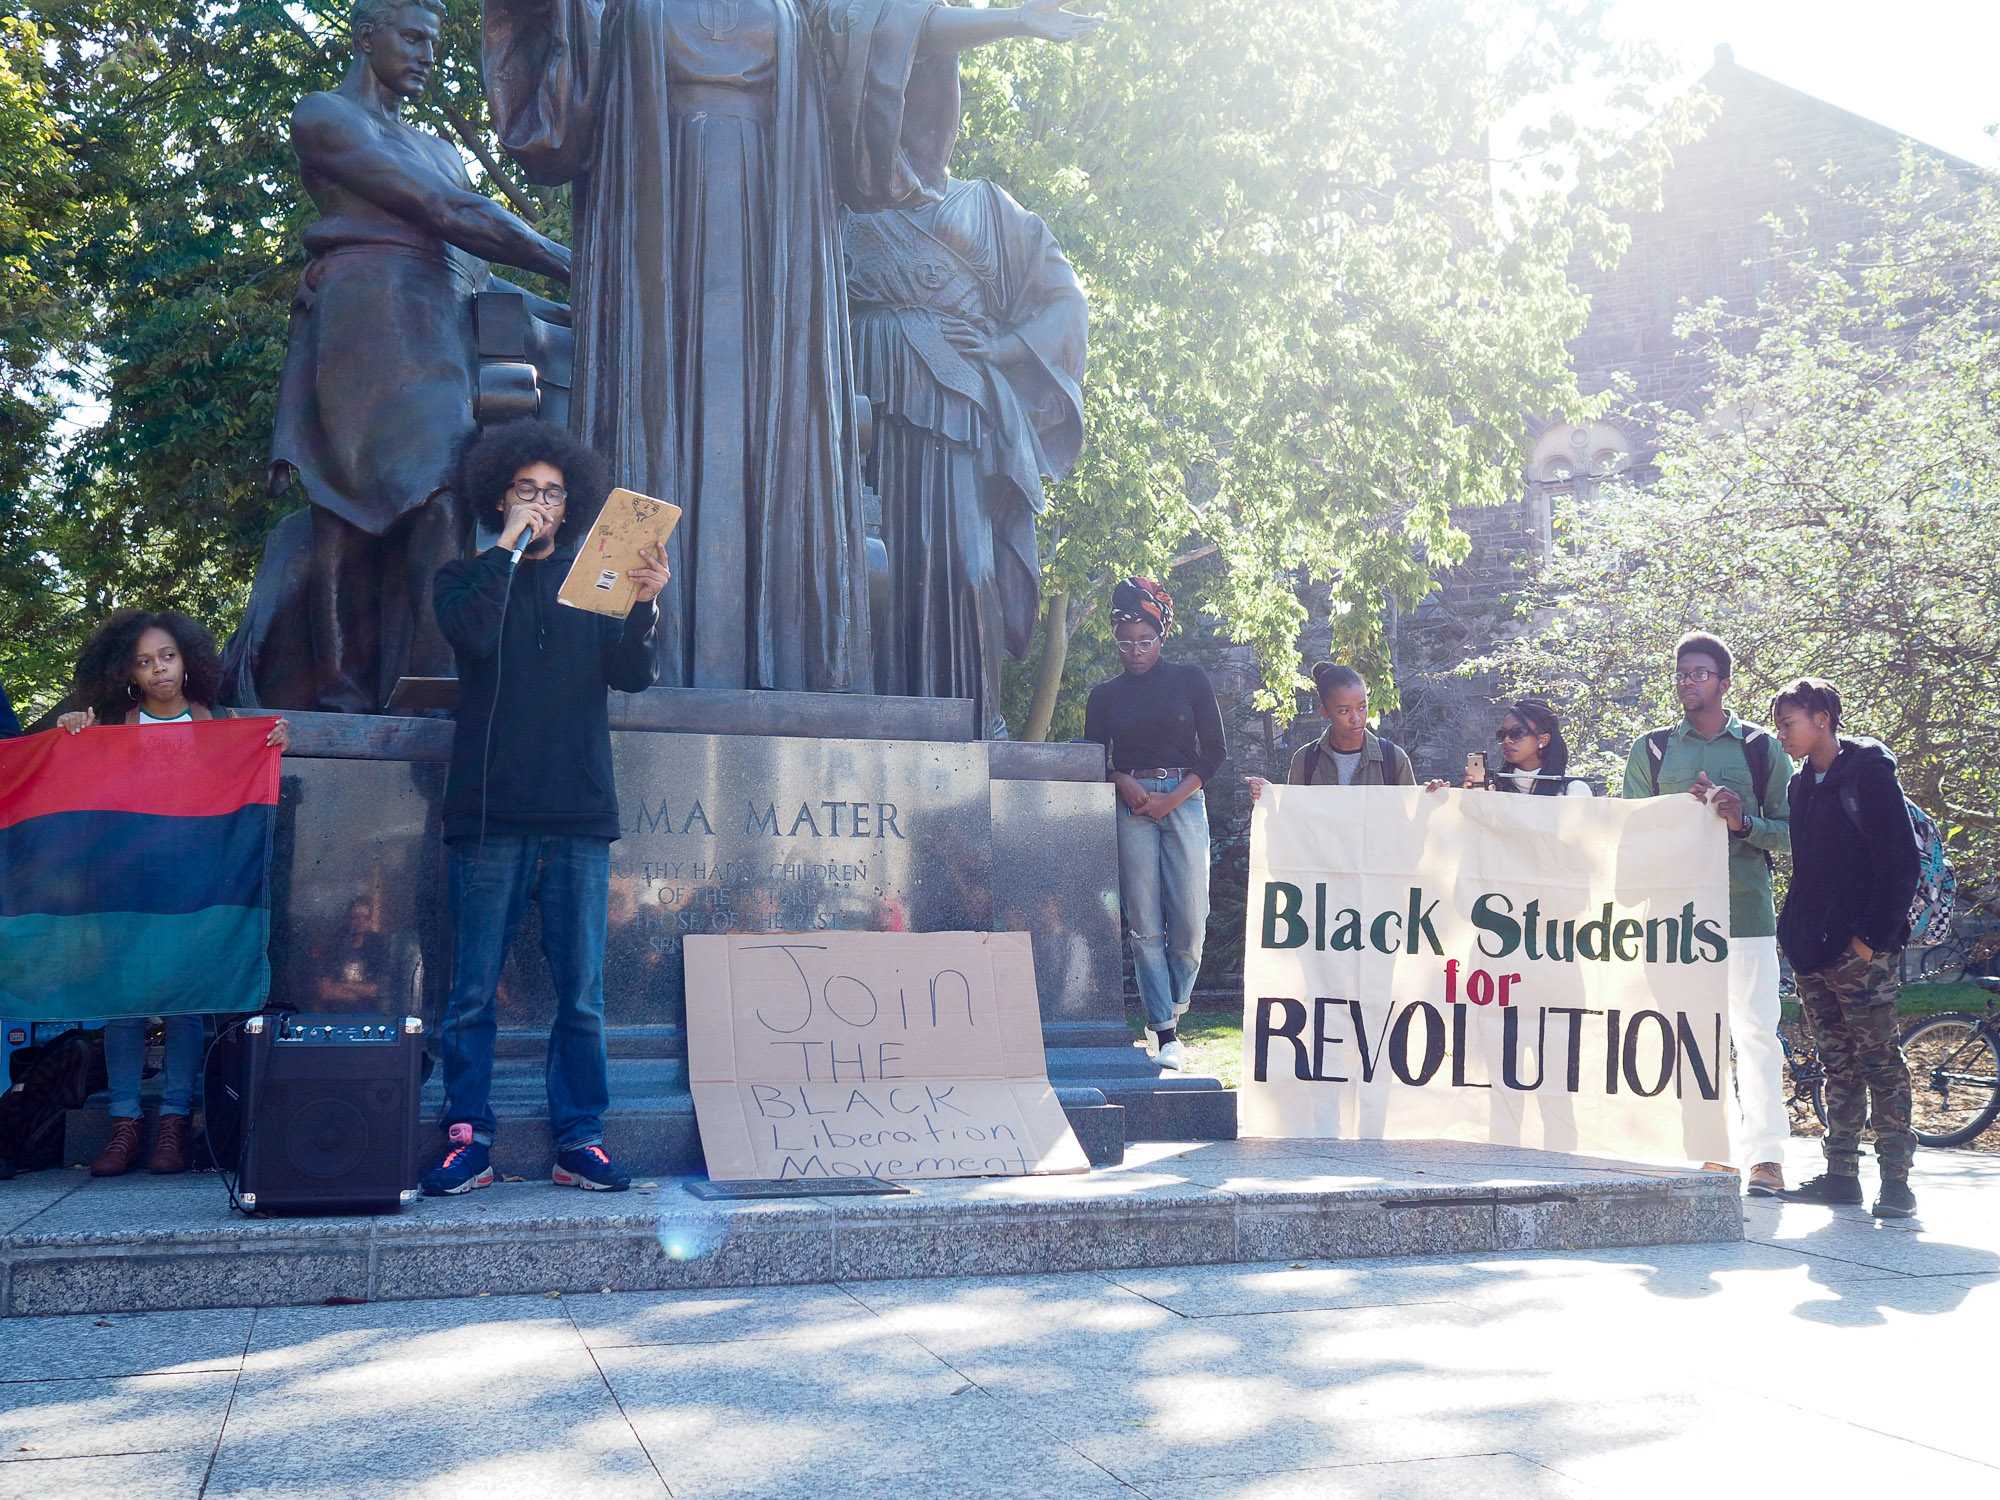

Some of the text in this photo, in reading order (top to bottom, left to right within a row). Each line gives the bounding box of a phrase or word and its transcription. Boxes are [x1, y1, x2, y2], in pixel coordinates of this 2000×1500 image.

[621, 798, 905, 839] MA MATER
[641, 862, 683, 880] THY
[769, 863, 868, 881] CHILDREN
[657, 886, 687, 905] OF
[693, 887, 731, 905] THE
[712, 911, 739, 930] OF
[1261, 881, 1729, 963] Black Students
[738, 944, 975, 1033] Join
[1444, 958, 1522, 1007] for
[770, 1041, 905, 1084] THE
[1254, 997, 1721, 1101] REVOLUTION
[750, 1083, 970, 1120] BLACK
[772, 1114, 1018, 1152] Liberation
[778, 1146, 1038, 1181] Movement
